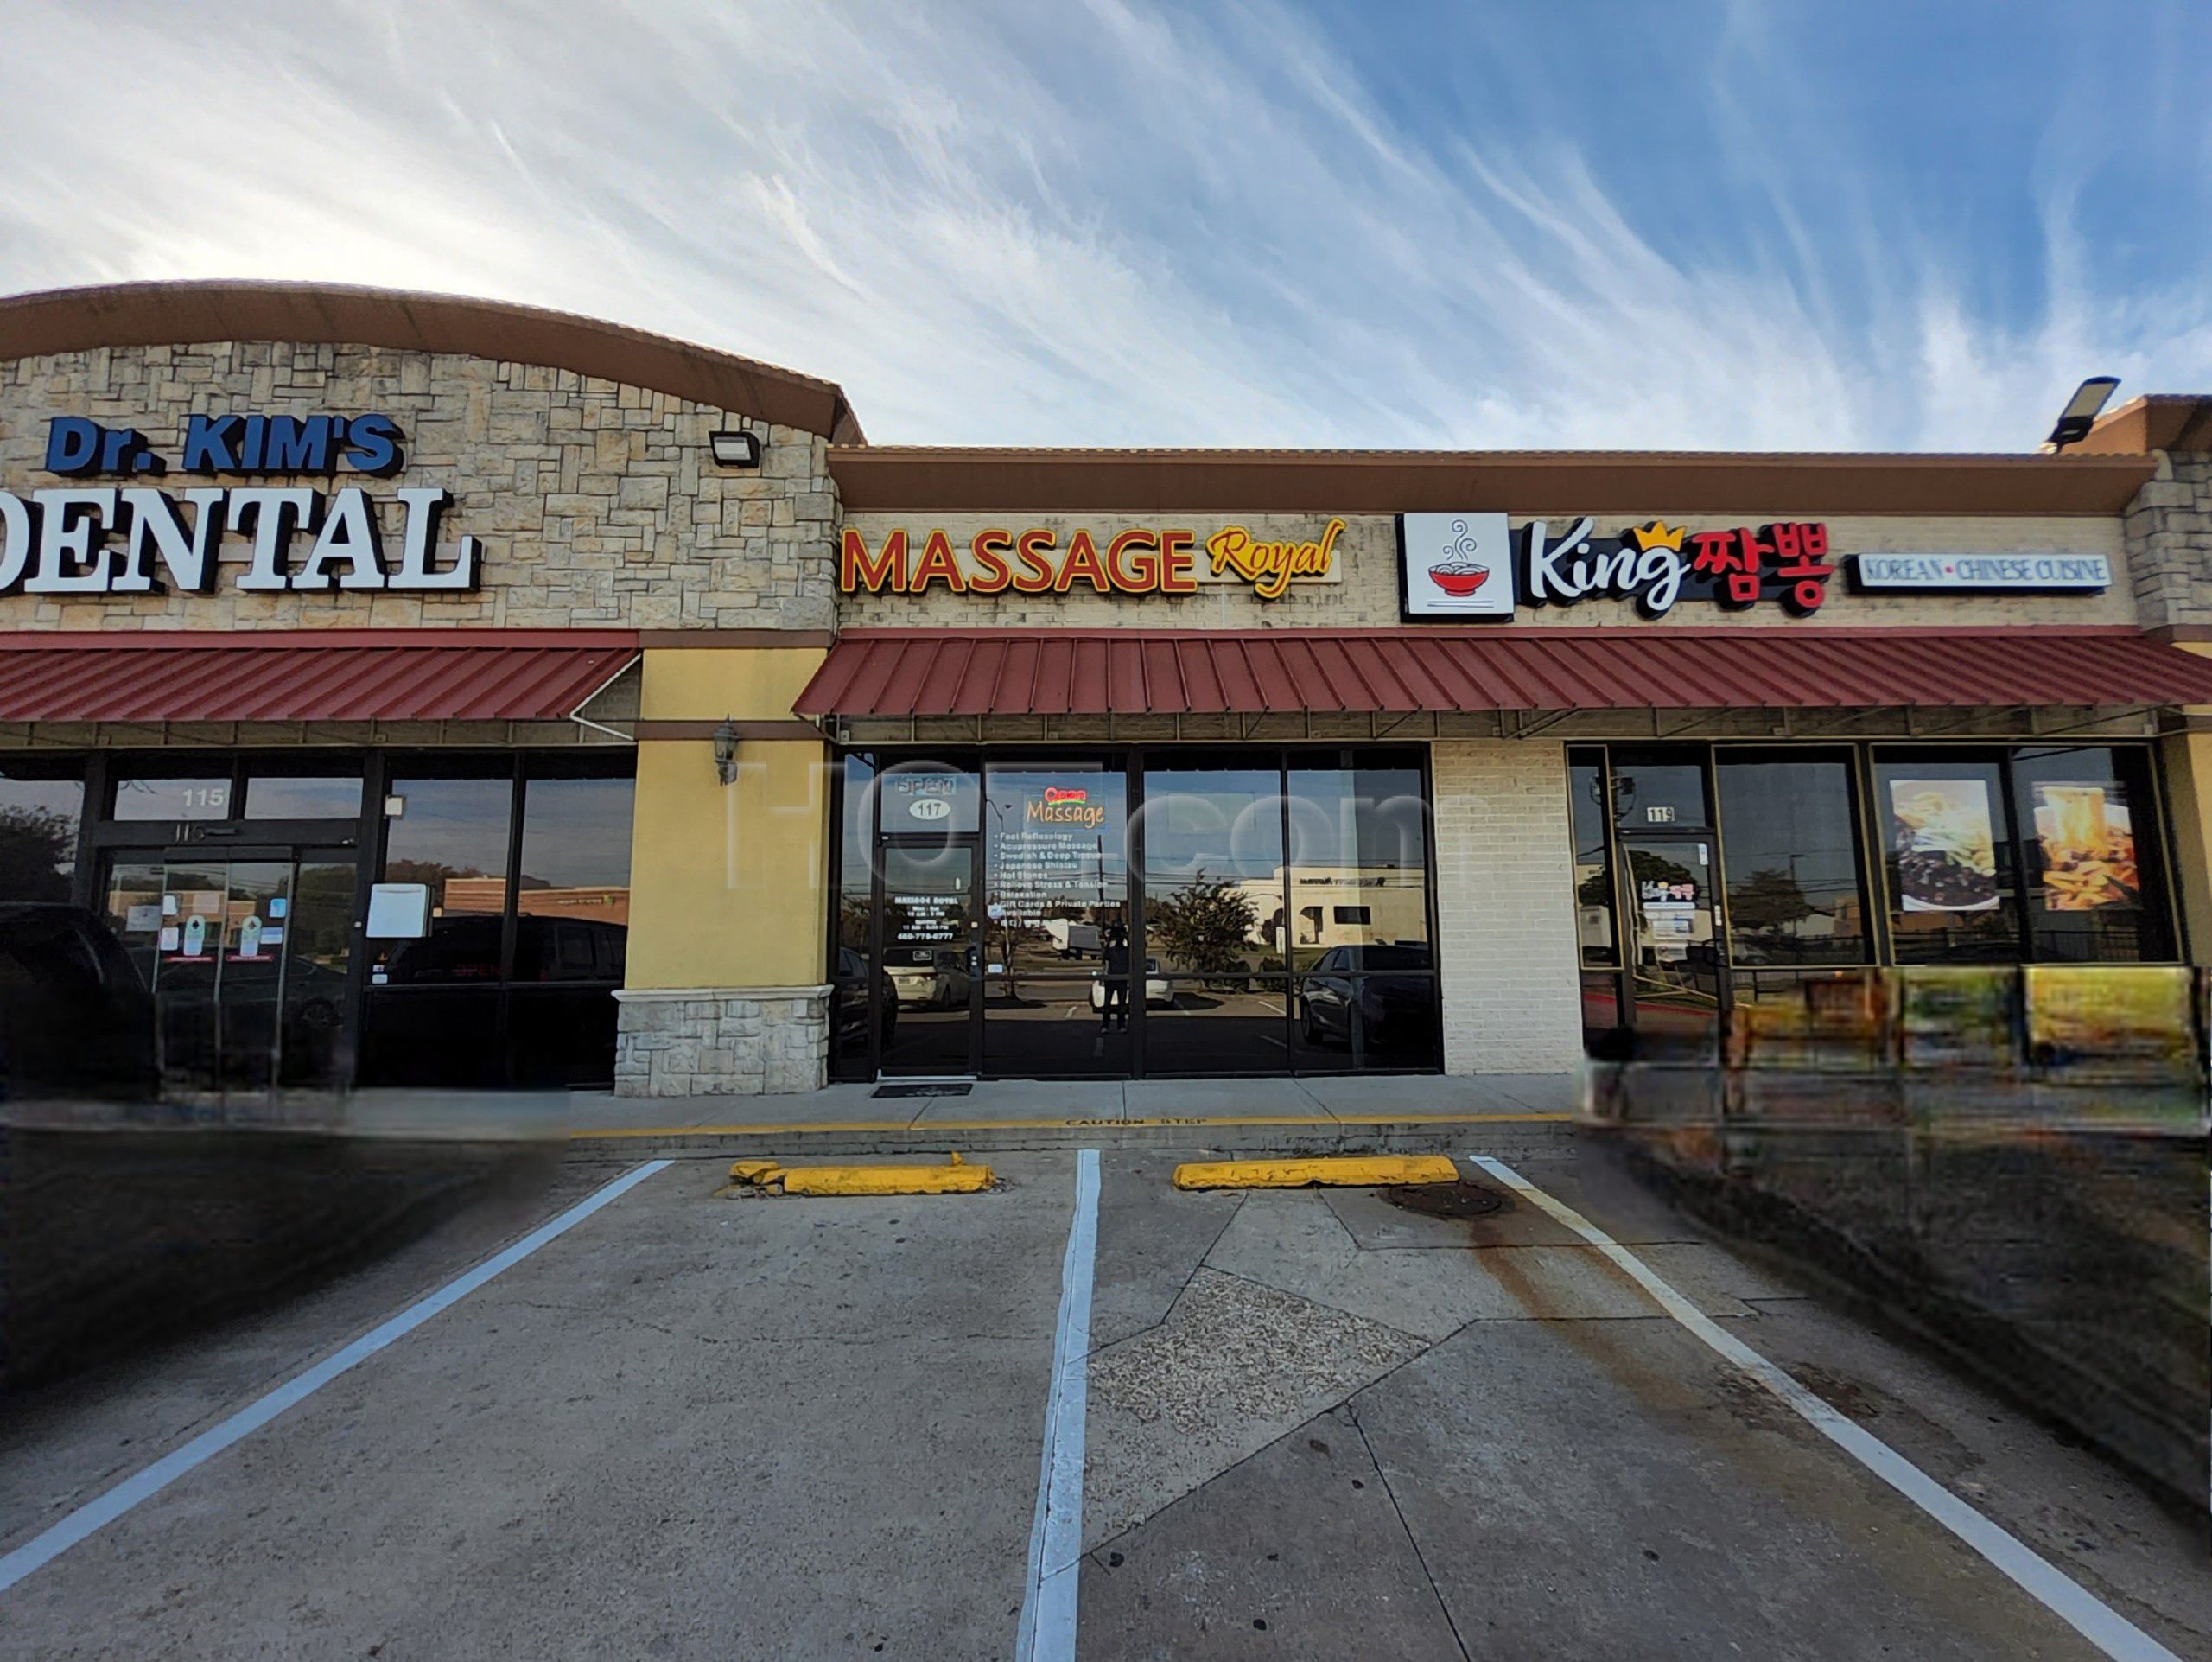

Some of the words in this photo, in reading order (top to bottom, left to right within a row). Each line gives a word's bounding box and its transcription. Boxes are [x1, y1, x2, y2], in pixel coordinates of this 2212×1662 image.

[44, 416, 154, 472] Dr.
[182, 414, 400, 473] KIM'S
[841, 527, 1198, 594] MASSAGE
[1206, 518, 1346, 600] Royal
[1530, 515, 1691, 611] King
[1692, 522, 1835, 608] 짬뽕
[1865, 559, 1942, 581] KOREAN
[1955, 559, 2031, 581] CHINESE
[2035, 558, 2107, 581] CUISINE
[182, 787, 225, 806] 115
[918, 803, 942, 817] 117
[1026, 800, 1104, 829] Massage
[1649, 808, 1674, 821] 119
